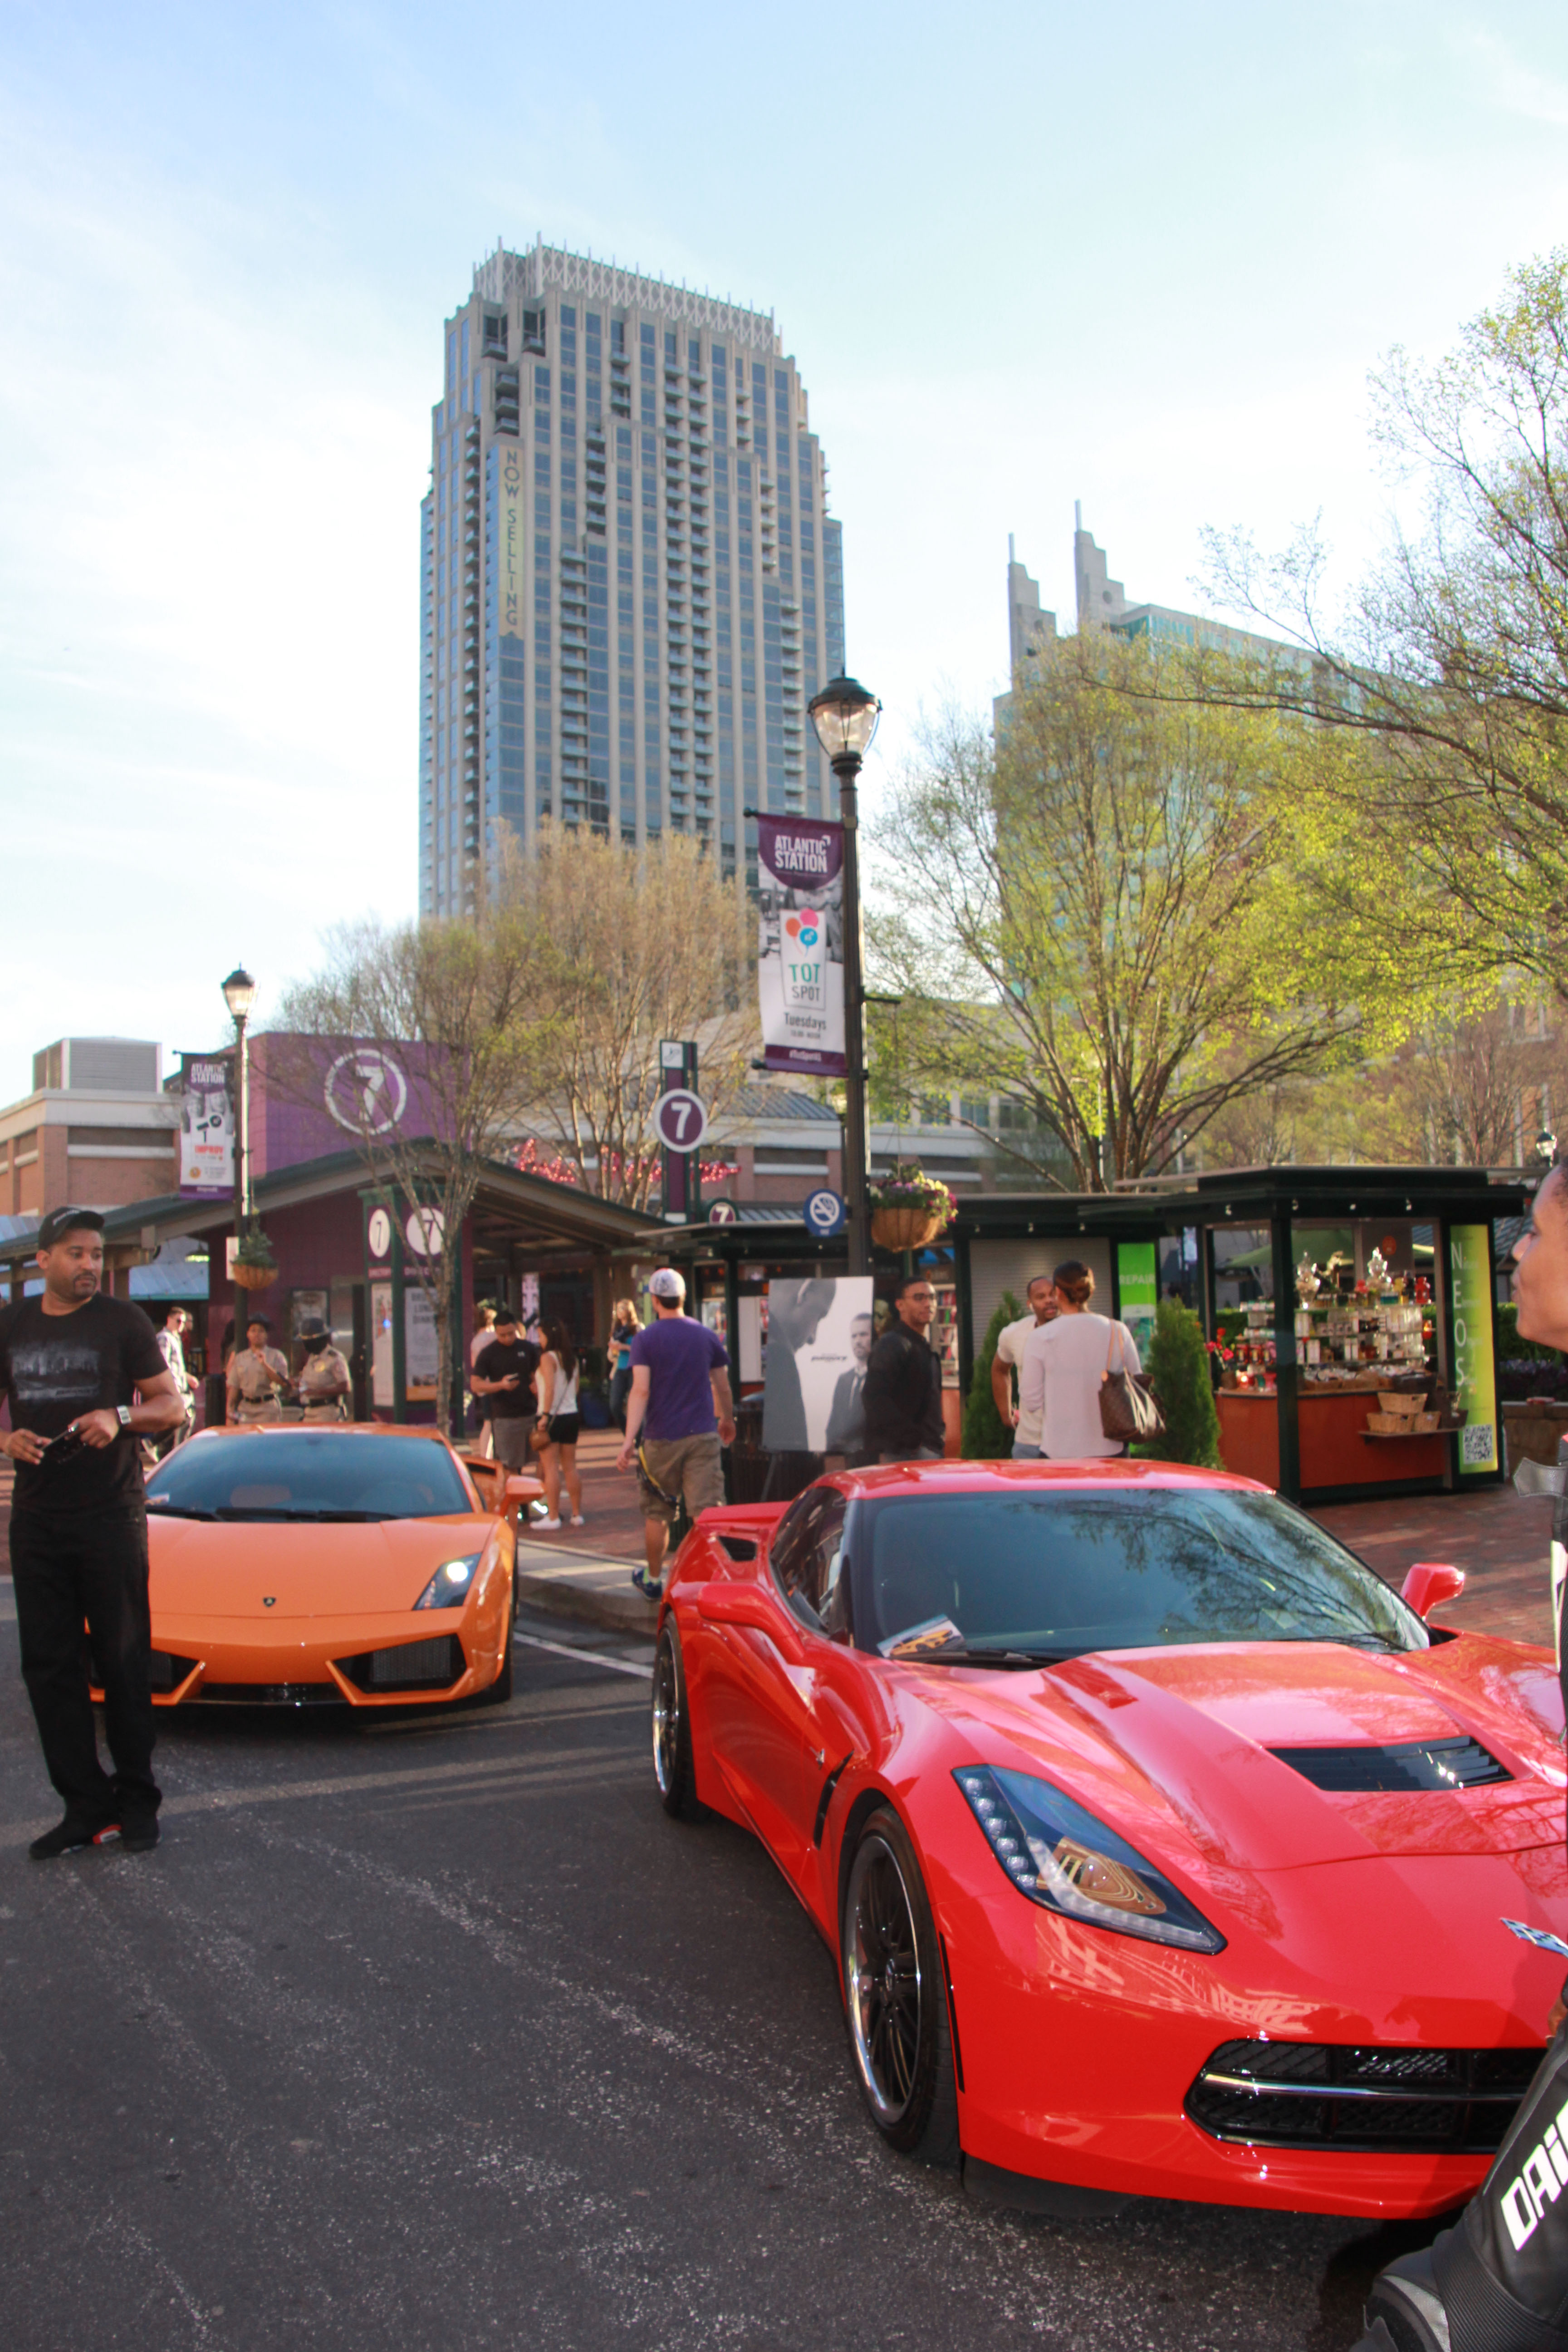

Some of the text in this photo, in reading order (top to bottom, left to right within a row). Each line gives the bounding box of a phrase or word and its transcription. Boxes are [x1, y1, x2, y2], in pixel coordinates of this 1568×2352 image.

[504, 451, 519, 626] NOW SELLING
[775, 835, 827, 856] ATLANTIC
[775, 851, 828, 873] STATION
[789, 963, 821, 983] TOT
[792, 985, 820, 1001] SPOT
[784, 1012, 827, 1030] Tuesdays
[191, 1072, 225, 1083] STATION
[355, 1066, 384, 1122] 7
[671, 1102, 691, 1140] 7
[715, 1206, 729, 1224] 7
[376, 1221, 382, 1249] 7
[1501, 2098, 1568, 2251] DAi
